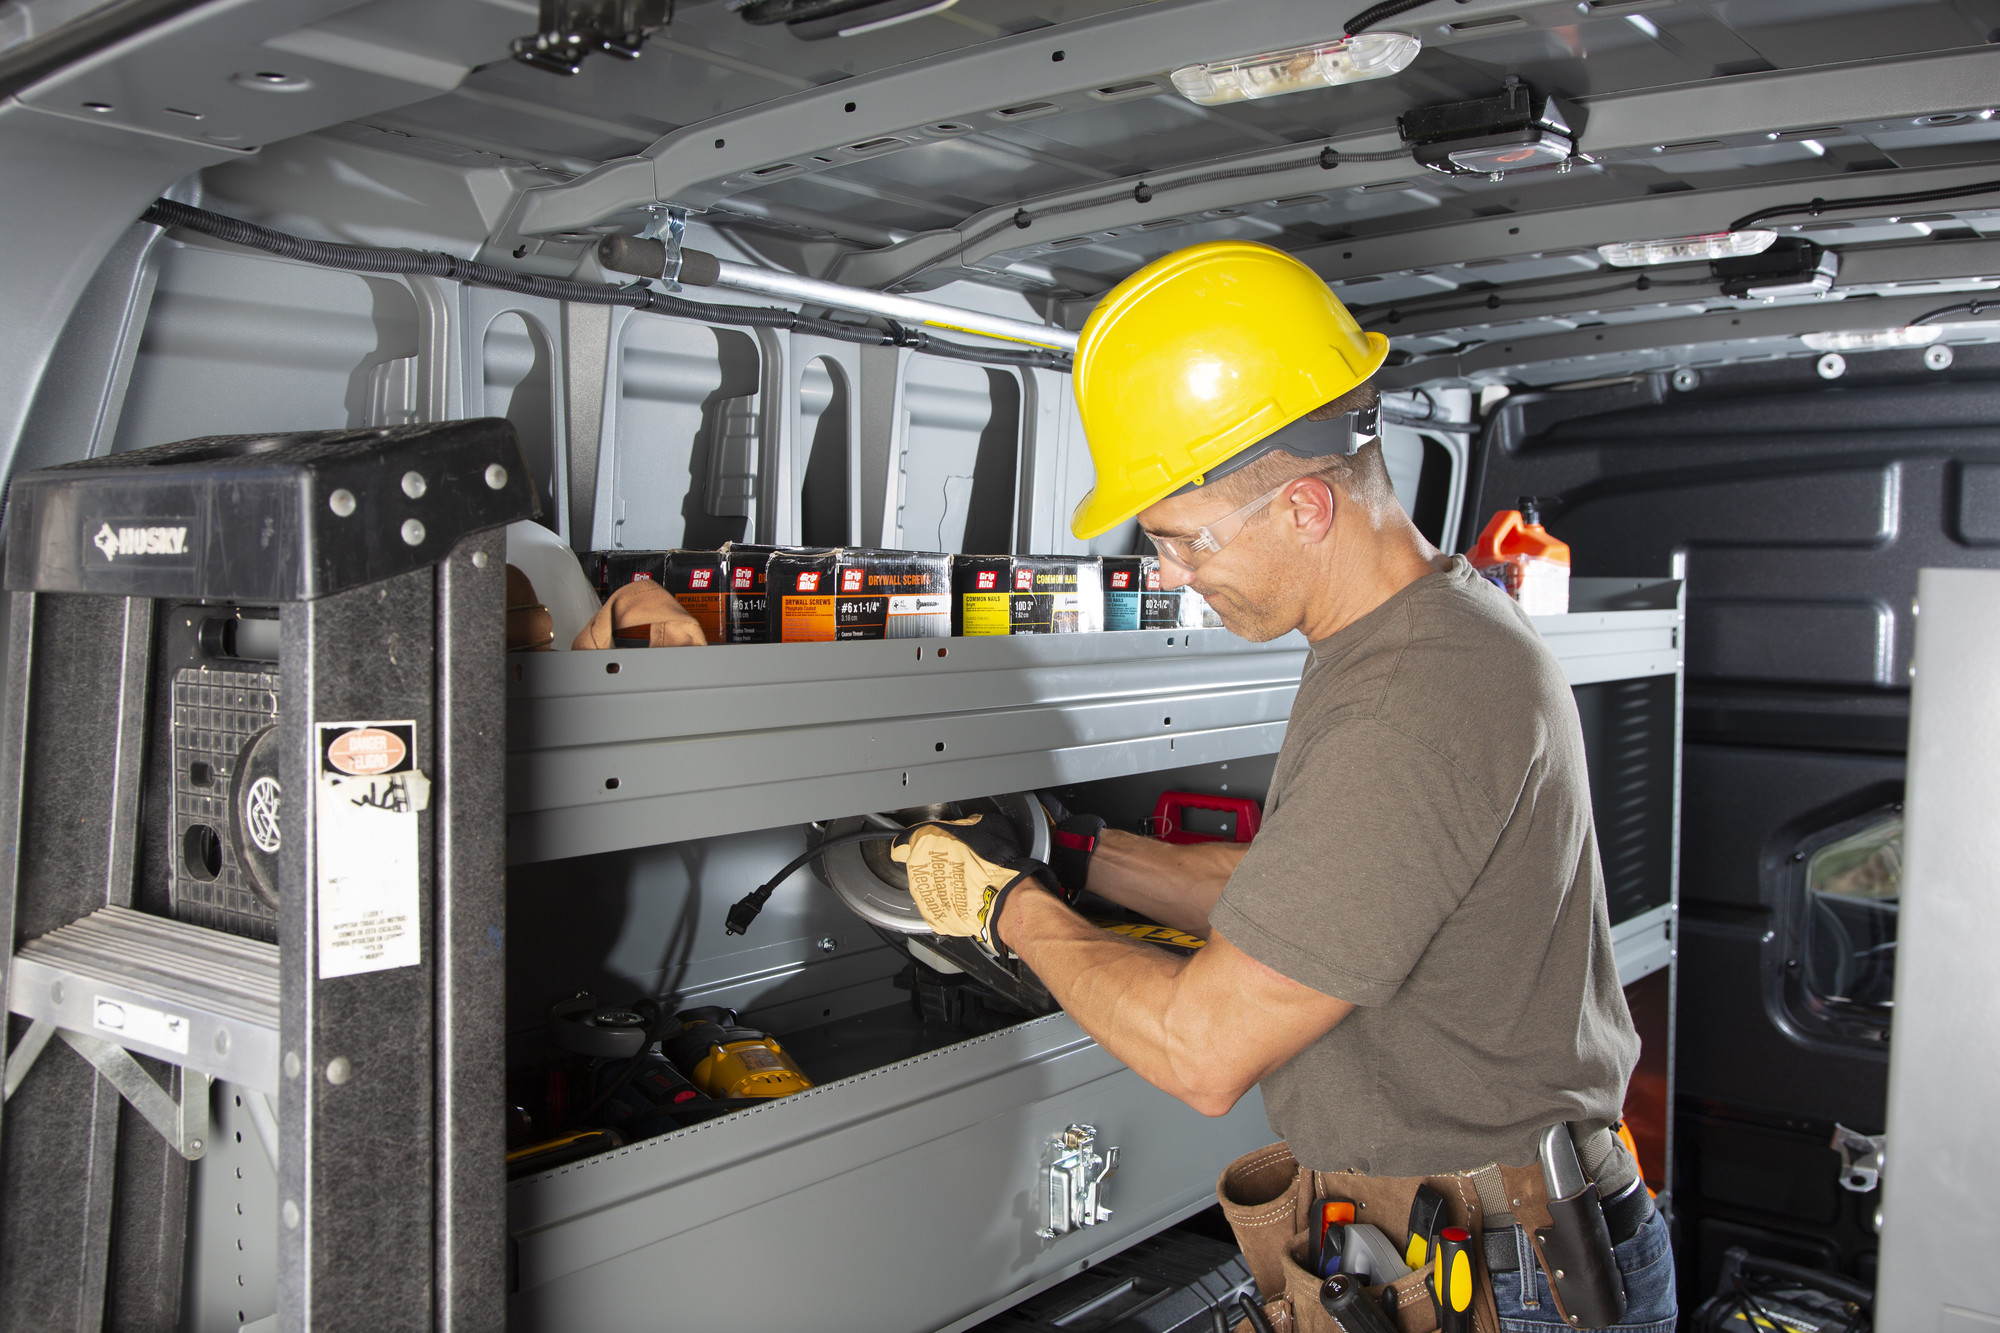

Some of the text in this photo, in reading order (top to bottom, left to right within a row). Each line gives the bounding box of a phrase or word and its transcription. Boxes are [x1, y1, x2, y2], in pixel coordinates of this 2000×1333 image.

[693, 570, 711, 580] Grip
[735, 568, 752, 579] Grip
[799, 572, 818, 582] Grip
[844, 570, 862, 580] Grip
[979, 572, 995, 581] Grip
[1017, 570, 1031, 580] Grip
[1112, 572, 1128, 580] Grip
[692, 579, 709, 588] Rite
[734, 578, 750, 588] Rite
[868, 574, 931, 586] DRYWALL SCREWS
[978, 580, 994, 588] Rite
[1016, 579, 1030, 588] Rite
[1036, 574, 1078, 585] COMMON NAIL
[798, 581, 815, 590] Rite
[843, 580, 860, 590] Rite
[732, 600, 743, 611] #6
[744, 602, 749, 610] x
[809, 598, 831, 606] SCREWS
[1014, 601, 1027, 611] 10D
[1145, 599, 1153, 609] 8D
[841, 602, 852, 614] #6
[853, 604, 858, 613] x
[840, 614, 851, 622] 3.18
[348, 735, 387, 752] DANGER
[928, 850, 952, 912] Mechanix
[909, 862, 948, 923] Mechanix
